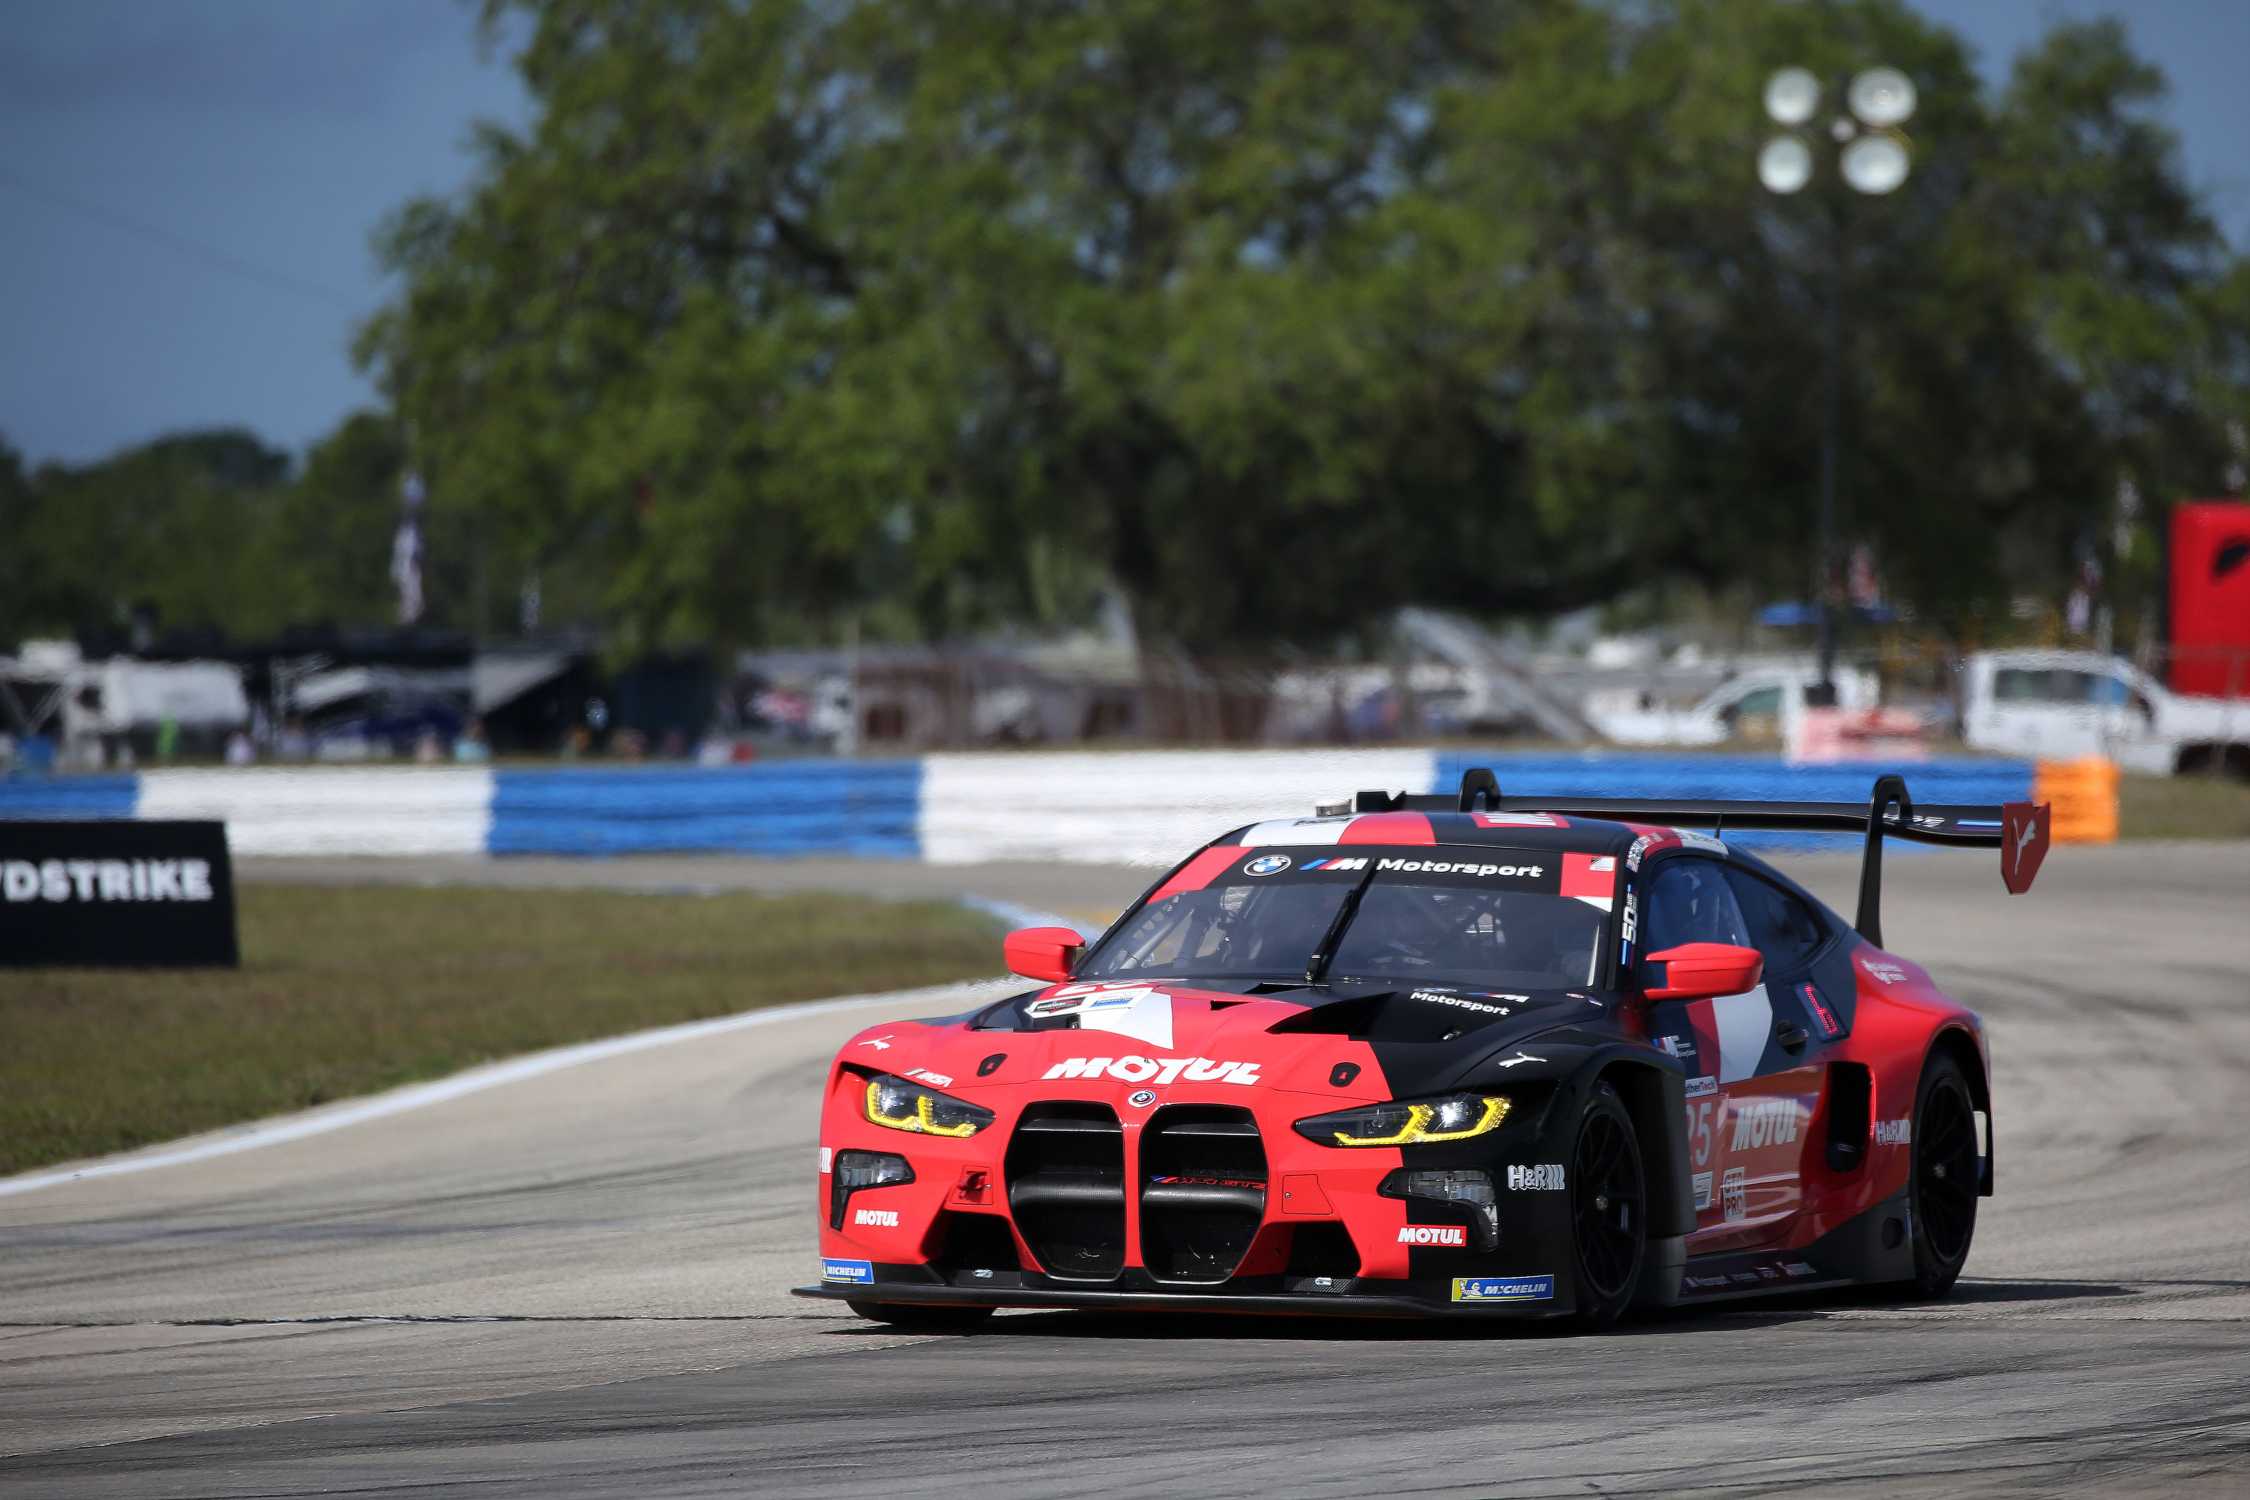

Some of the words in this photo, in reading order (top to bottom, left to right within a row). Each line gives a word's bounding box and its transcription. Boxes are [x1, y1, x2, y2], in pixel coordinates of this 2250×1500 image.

[1376, 858, 1544, 878] Motorsport
[0, 858, 213, 902] DSTRIKE
[1410, 992, 1510, 1016] Motorsport
[1040, 1055, 1262, 1085] MOTUL
[1730, 1098, 1798, 1153] MOTUL
[854, 1209, 899, 1227] MOTUL
[1397, 1227, 1463, 1244] MOTUL
[826, 1266, 867, 1277] MICHELIN
[1484, 1283, 1547, 1295] MICHELIN
